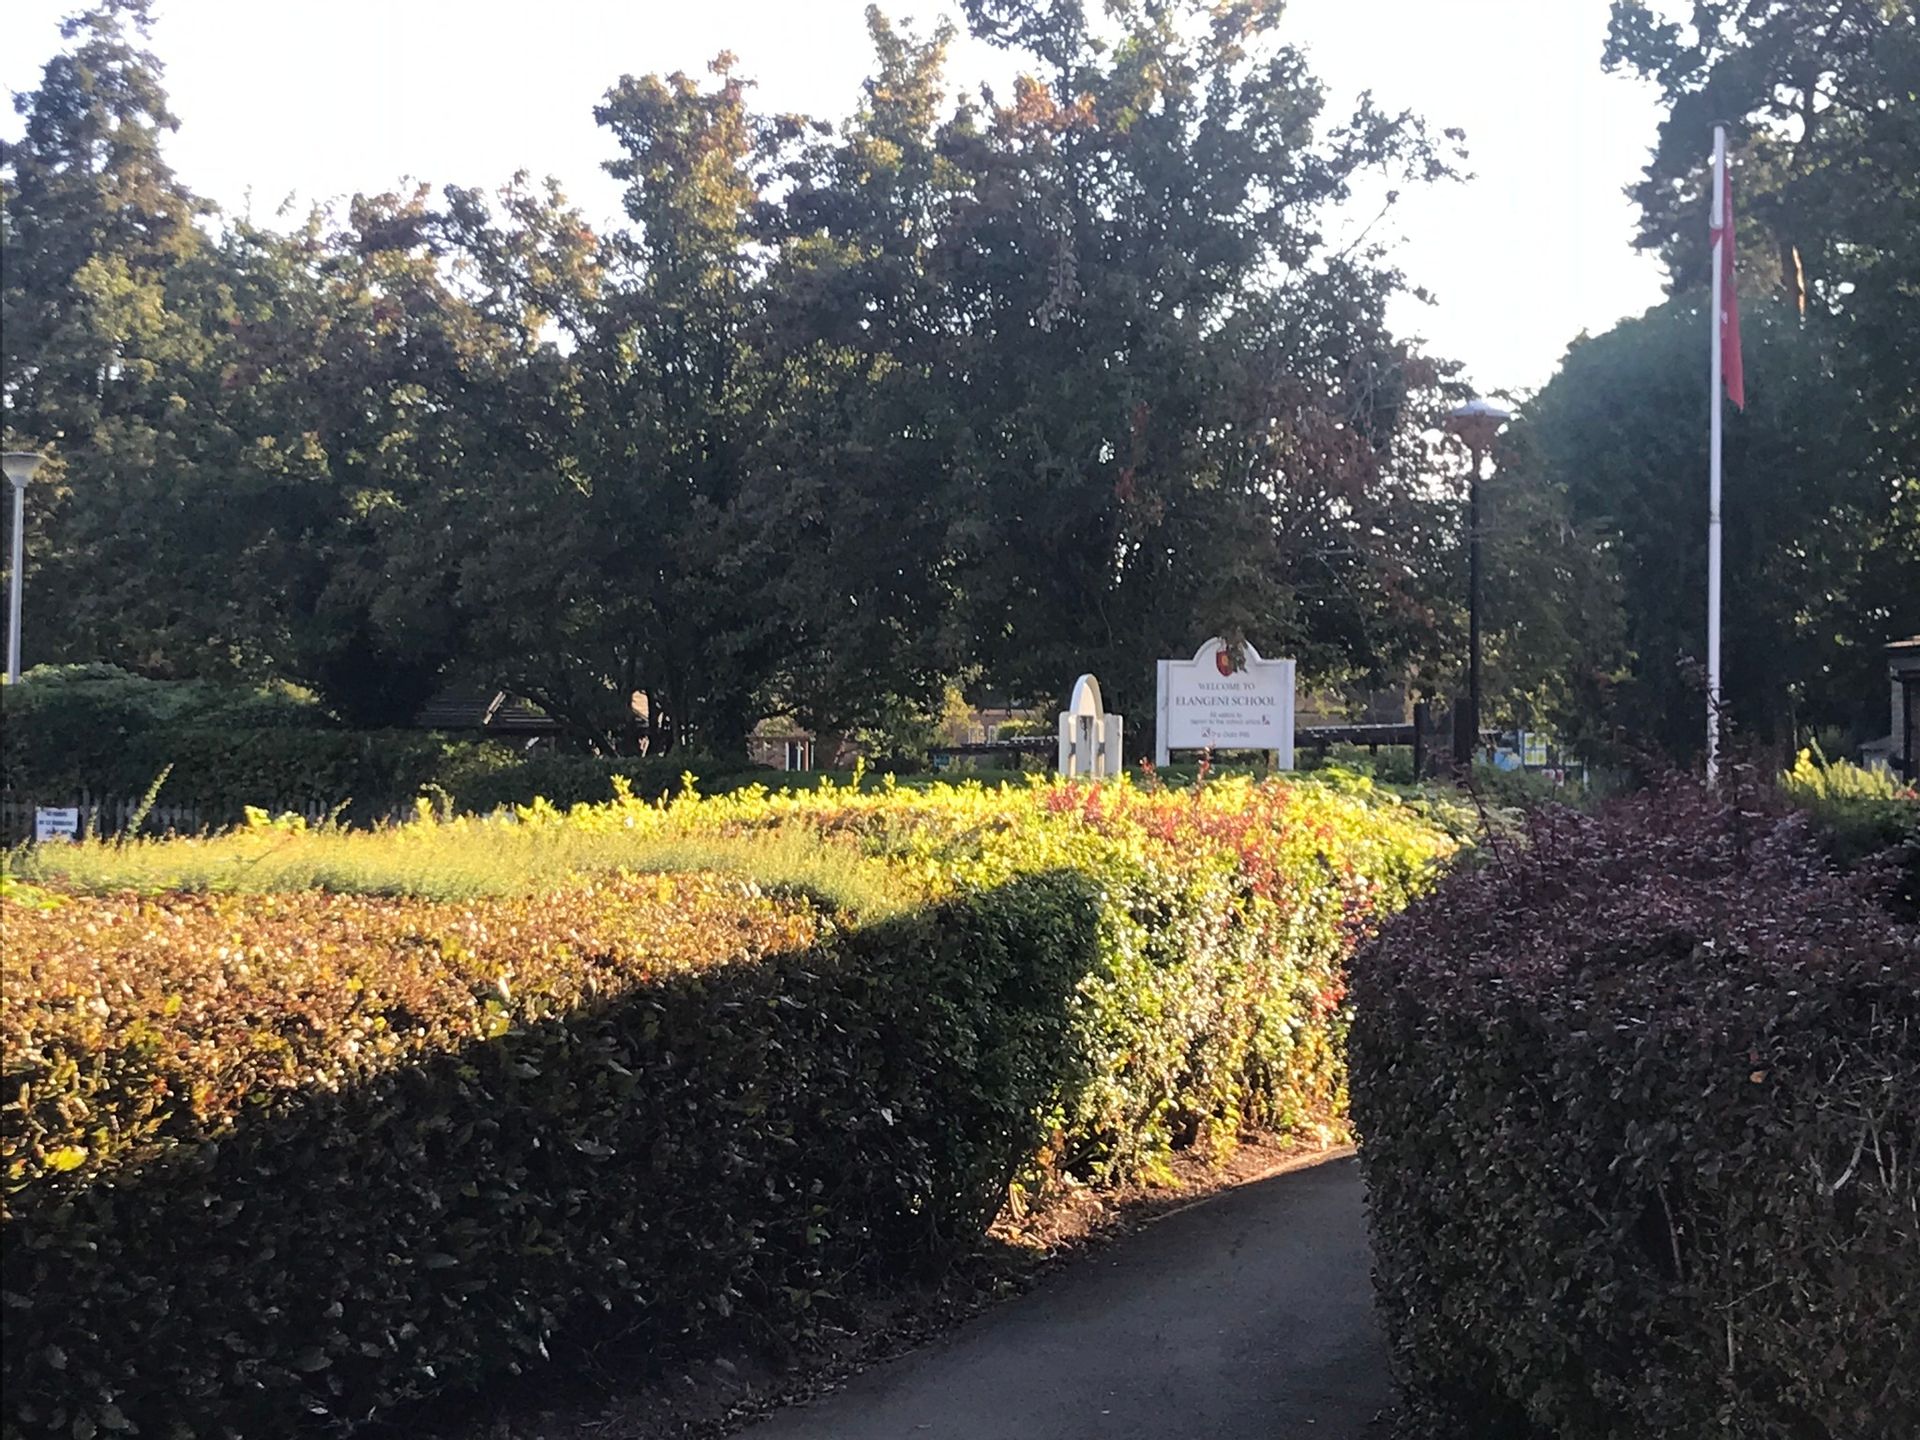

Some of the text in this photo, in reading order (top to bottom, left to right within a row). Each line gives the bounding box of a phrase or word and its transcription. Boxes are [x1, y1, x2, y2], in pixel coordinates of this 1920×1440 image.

[1198, 682, 1256, 690] WELCOME TO
[1175, 696, 1276, 706] ELANGENI SCHOOL
